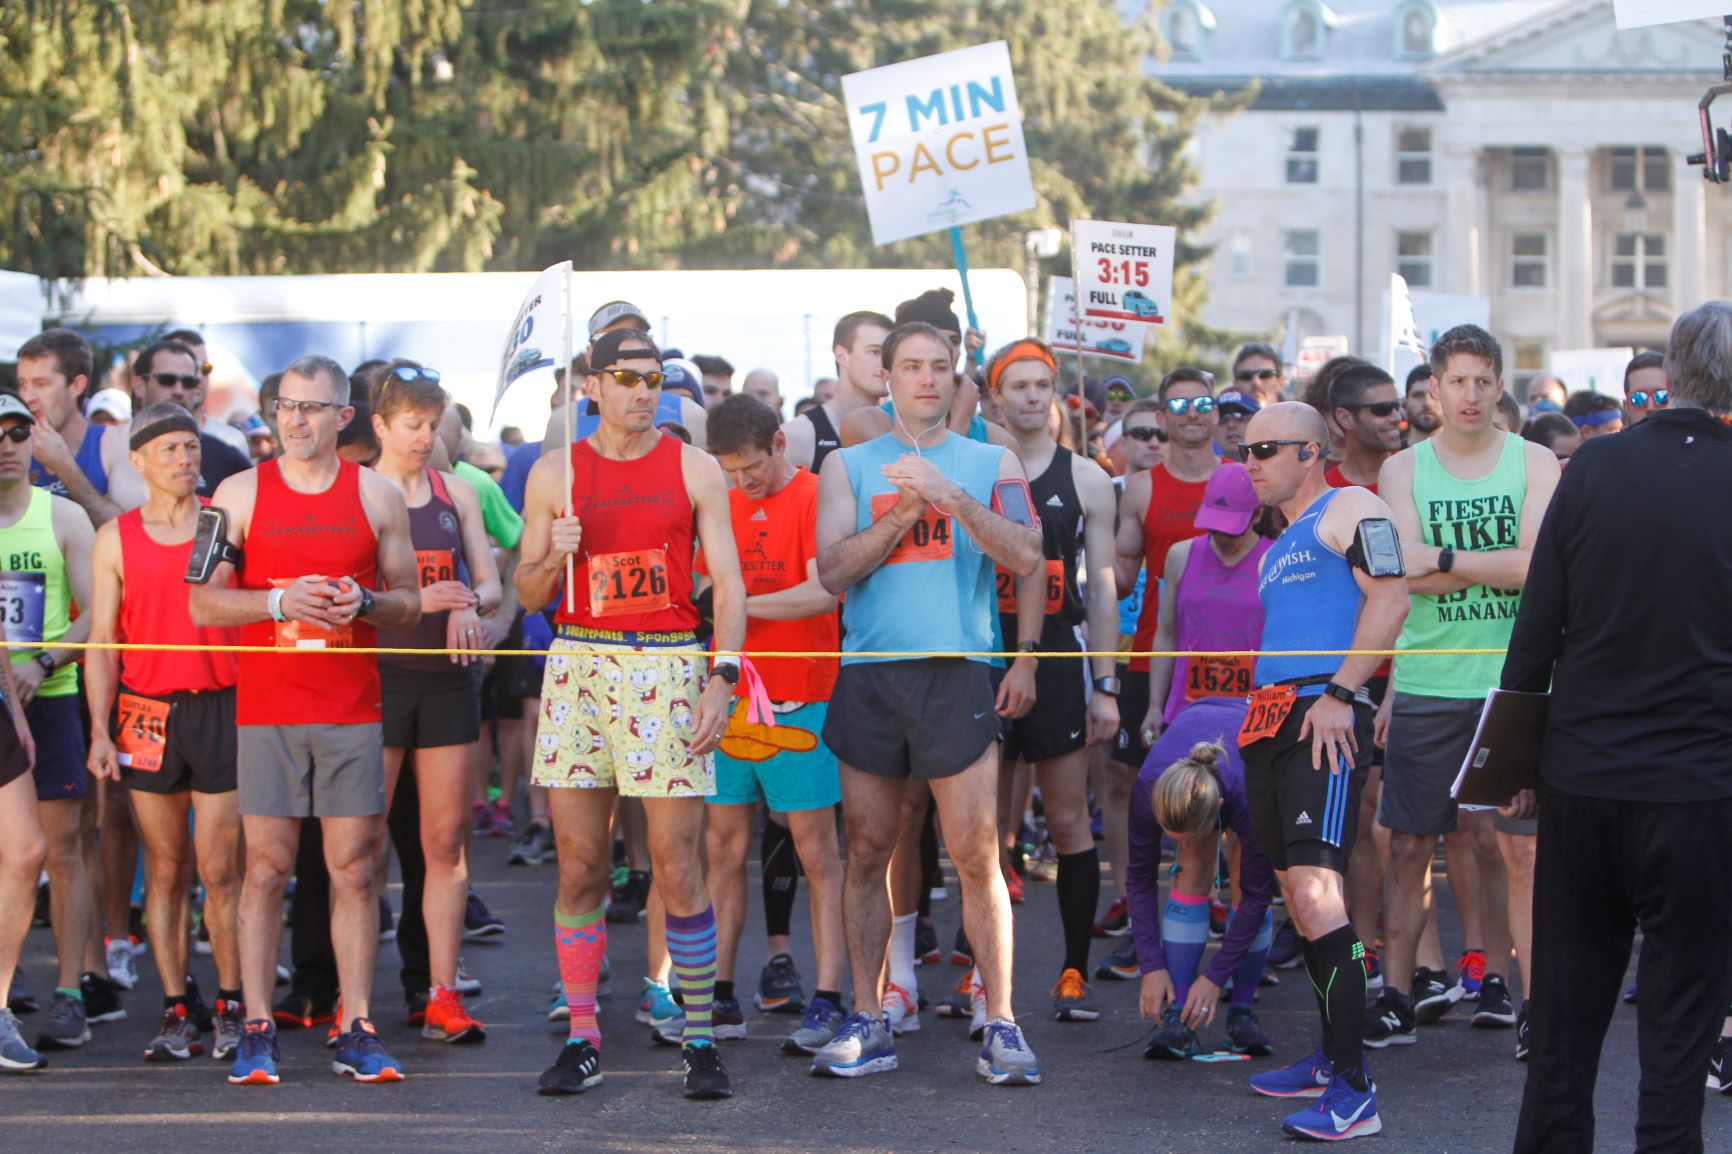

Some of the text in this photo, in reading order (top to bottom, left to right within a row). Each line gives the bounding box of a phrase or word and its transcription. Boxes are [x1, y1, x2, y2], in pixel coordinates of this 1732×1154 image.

[859, 75, 1006, 143] 7 MIN
[871, 122, 1016, 191] PACE
[1091, 242, 1157, 258] PACE SETTER
[1097, 257, 1149, 287] 3:15
[1089, 291, 1117, 305] FULL
[1428, 495, 1516, 521] FIESTA
[896, 518, 949, 549] 04
[1429, 515, 1516, 551] LIKE
[612, 555, 641, 567] Scot
[591, 565, 666, 601] 2126
[1282, 571, 1316, 584] Michigan
[1437, 601, 1518, 623] MAÑANA
[1190, 665, 1250, 692] 1529
[1257, 690, 1286, 701] William
[1242, 701, 1291, 733] 1266
